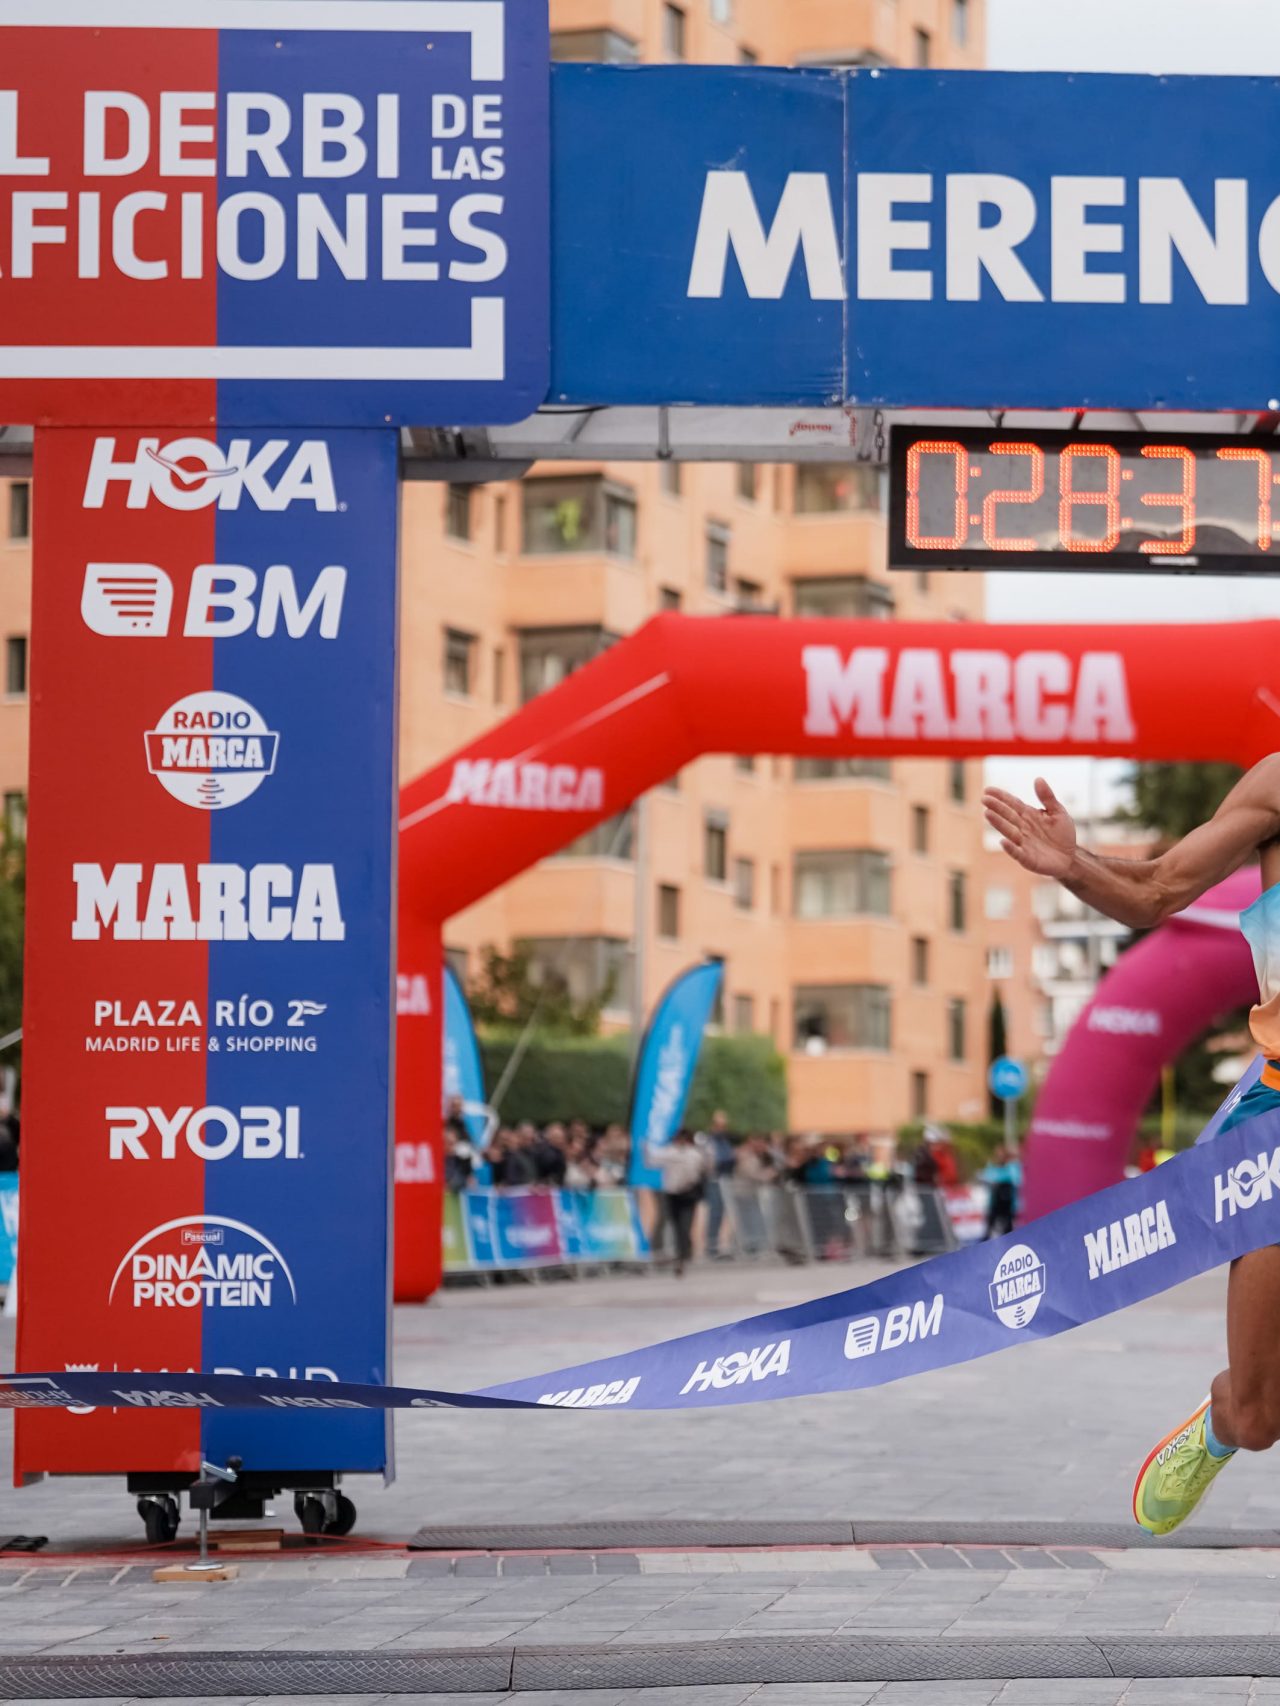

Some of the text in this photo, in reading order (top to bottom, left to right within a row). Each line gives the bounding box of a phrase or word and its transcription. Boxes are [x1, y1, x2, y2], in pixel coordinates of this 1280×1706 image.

[0, 89, 399, 179] L DERBI
[431, 94, 502, 139] DE
[432, 146, 505, 181] LAS
[0, 190, 508, 283] FICIONES
[82, 437, 338, 512] HOKA
[183, 564, 347, 640] BM
[801, 645, 1137, 744] MARCA
[173, 712, 251, 730] RADIO
[161, 737, 264, 769] MARCA
[446, 759, 604, 811] MARCA
[72, 863, 345, 941] MARCA
[95, 1000, 202, 1027] PLAZA
[215, 994, 274, 1027] RÍO
[86, 1037, 318, 1052] MADRID LIFE & SHOPPING
[105, 1106, 300, 1160] RYOBI
[184, 1231, 220, 1242] Pascual
[1084, 1201, 1176, 1280] MARCA
[132, 1246, 274, 1280] DINAMIC
[1000, 1254, 1033, 1277] RADIO
[133, 1280, 271, 1307] PROTEIN
[996, 1271, 1041, 1306] MARCA
[881, 1294, 944, 1352] BM
[680, 1340, 792, 1395] HOKA
